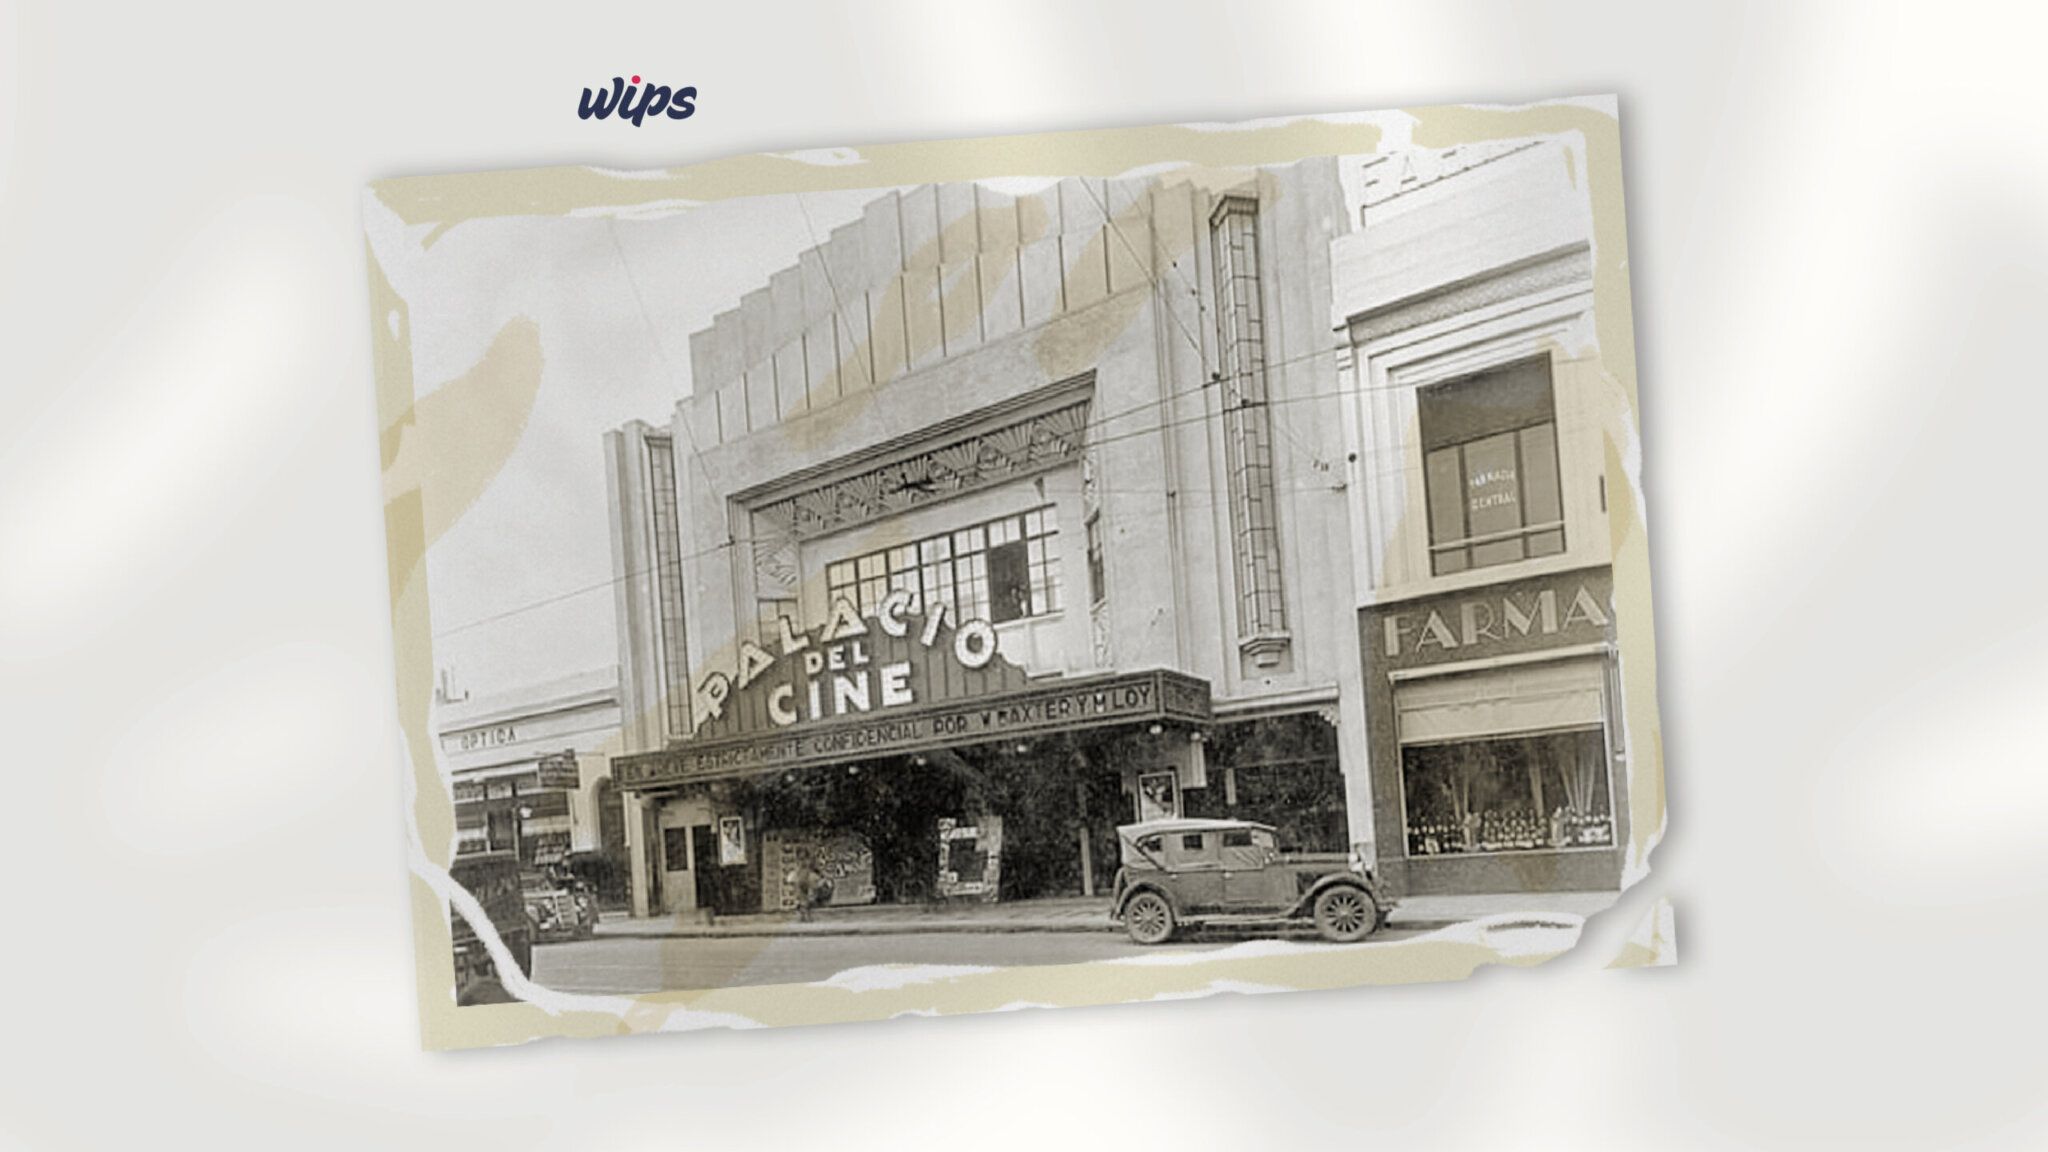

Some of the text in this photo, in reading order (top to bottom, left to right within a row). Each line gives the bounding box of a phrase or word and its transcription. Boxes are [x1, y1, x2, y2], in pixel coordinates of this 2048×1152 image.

[1383, 584, 1610, 657] FARMA
[697, 588, 998, 725] PALACIO
[804, 640, 869, 675] DEL
[768, 660, 914, 726] CINE
[461, 726, 517, 750] OPTICA
[814, 723, 920, 753] CONFIDENCIAL
[932, 716, 968, 737] POR
